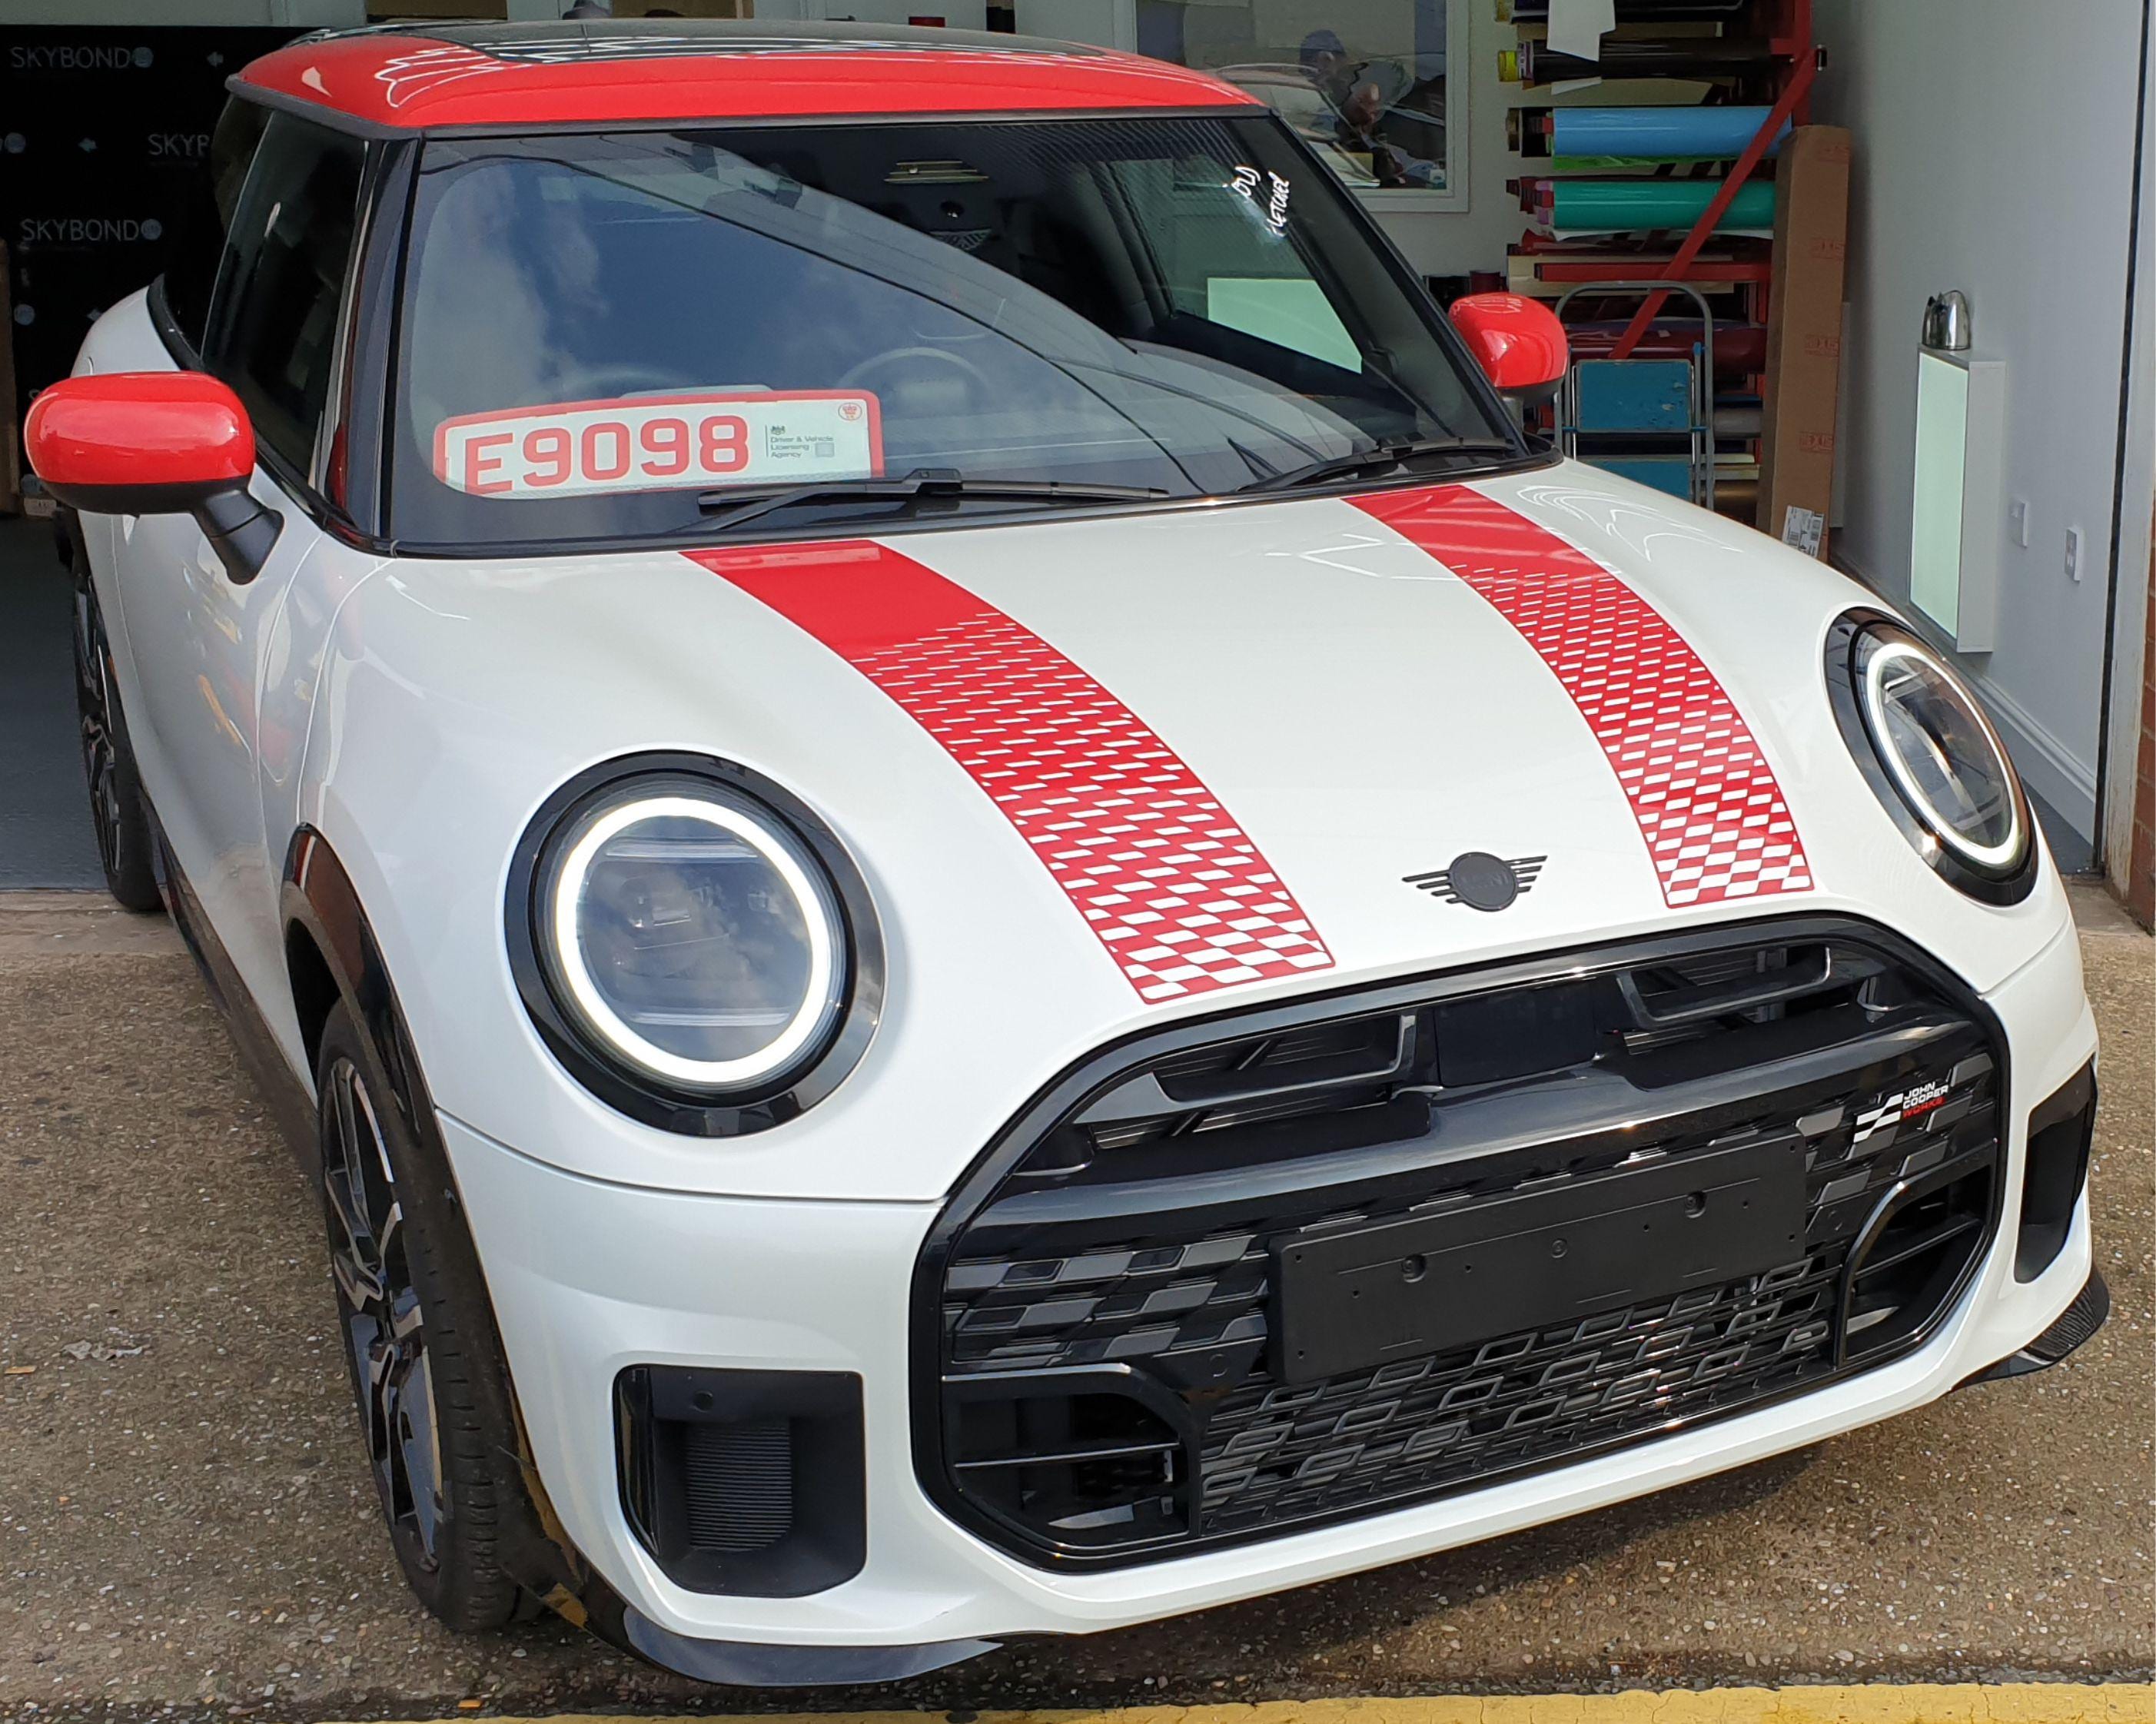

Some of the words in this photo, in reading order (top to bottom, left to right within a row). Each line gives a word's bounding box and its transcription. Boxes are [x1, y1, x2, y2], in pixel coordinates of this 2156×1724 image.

[9, 46, 130, 68] SKYBOND
[20, 218, 139, 241] SKYBOND
[465, 415, 749, 494] E9098
[1902, 1085, 1949, 1109] COOPER
[1904, 1081, 1935, 1100] JOHN
[1903, 1096, 1944, 1118] WORKS
